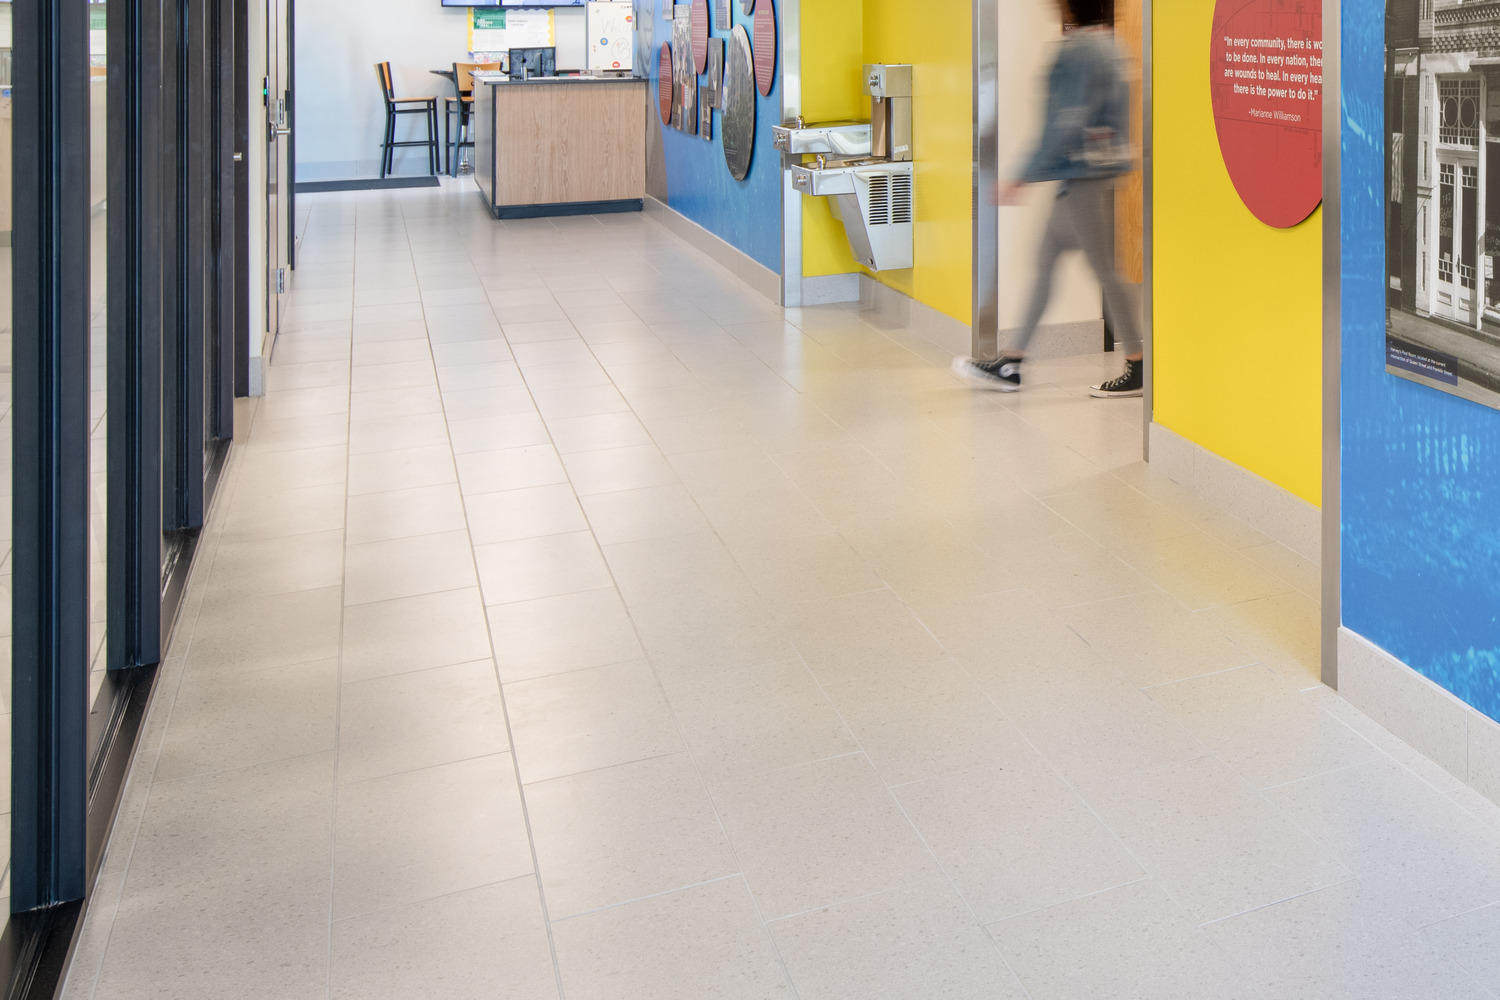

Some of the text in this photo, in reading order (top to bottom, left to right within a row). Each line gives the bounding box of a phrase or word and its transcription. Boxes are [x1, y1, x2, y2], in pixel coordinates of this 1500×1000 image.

[1234, 38, 1249, 48] every
[1251, 37, 1285, 50] community,
[1287, 37, 1304, 49] there
[1306, 38, 1311, 49] is
[1226, 52, 1232, 62] to
[1233, 52, 1240, 62] be
[1242, 52, 1258, 63] done.
[1260, 53, 1265, 63] In
[1267, 56, 1284, 66] every
[1286, 55, 1308, 68] nation,
[1224, 69, 1233, 77] are
[1235, 69, 1257, 78] wounds
[1258, 70, 1265, 79] to
[1266, 70, 1280, 80] heal.
[1283, 71, 1288, 81] In
[1290, 74, 1308, 85] every
[1234, 83, 1249, 94] there
[1250, 84, 1255, 95] is
[1256, 85, 1266, 95] the
[1268, 89, 1287, 98] power
[1289, 88, 1296, 98] to
[1297, 88, 1306, 100] do
[1273, 111, 1301, 122] Williamson
